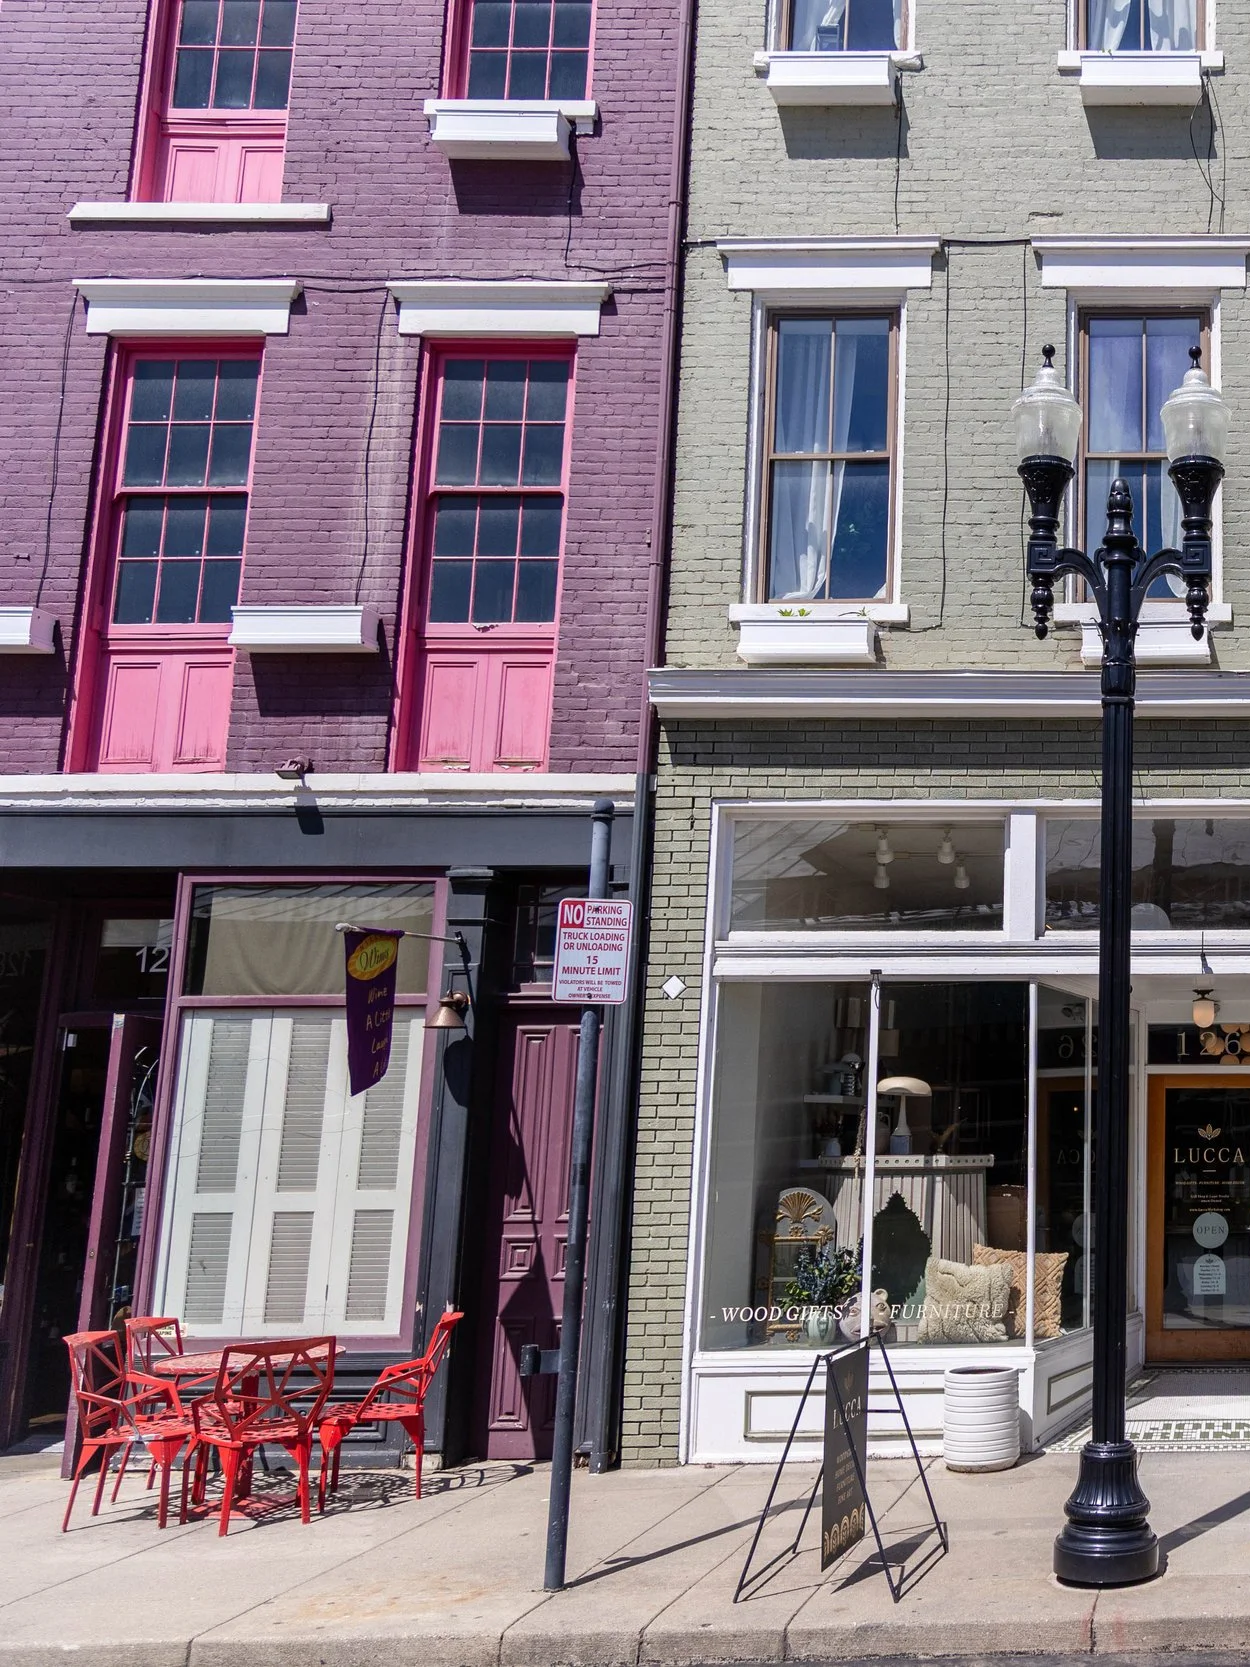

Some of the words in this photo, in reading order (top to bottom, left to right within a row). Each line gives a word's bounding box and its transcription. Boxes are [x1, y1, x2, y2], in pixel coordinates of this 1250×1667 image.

[563, 904, 583, 925] NO
[587, 905, 622, 915] PARKING
[586, 916, 627, 927] STANDING
[563, 931, 589, 941] TRUCK
[590, 932, 625, 942] LOADING
[563, 942, 575, 951] OR
[576, 942, 623, 952] UNLOADING
[586, 955, 599, 965] 15
[561, 966, 596, 976] MINUTE
[597, 967, 621, 976] LIMIT
[1176, 1031, 1241, 1056] 126
[1174, 1147, 1245, 1164] LUCCA
[1196, 1226, 1225, 1235] OPEN
[722, 1305, 783, 1322] WOOD
[785, 1304, 844, 1322] GIFTS
[888, 1303, 1005, 1320] FURNITURE
